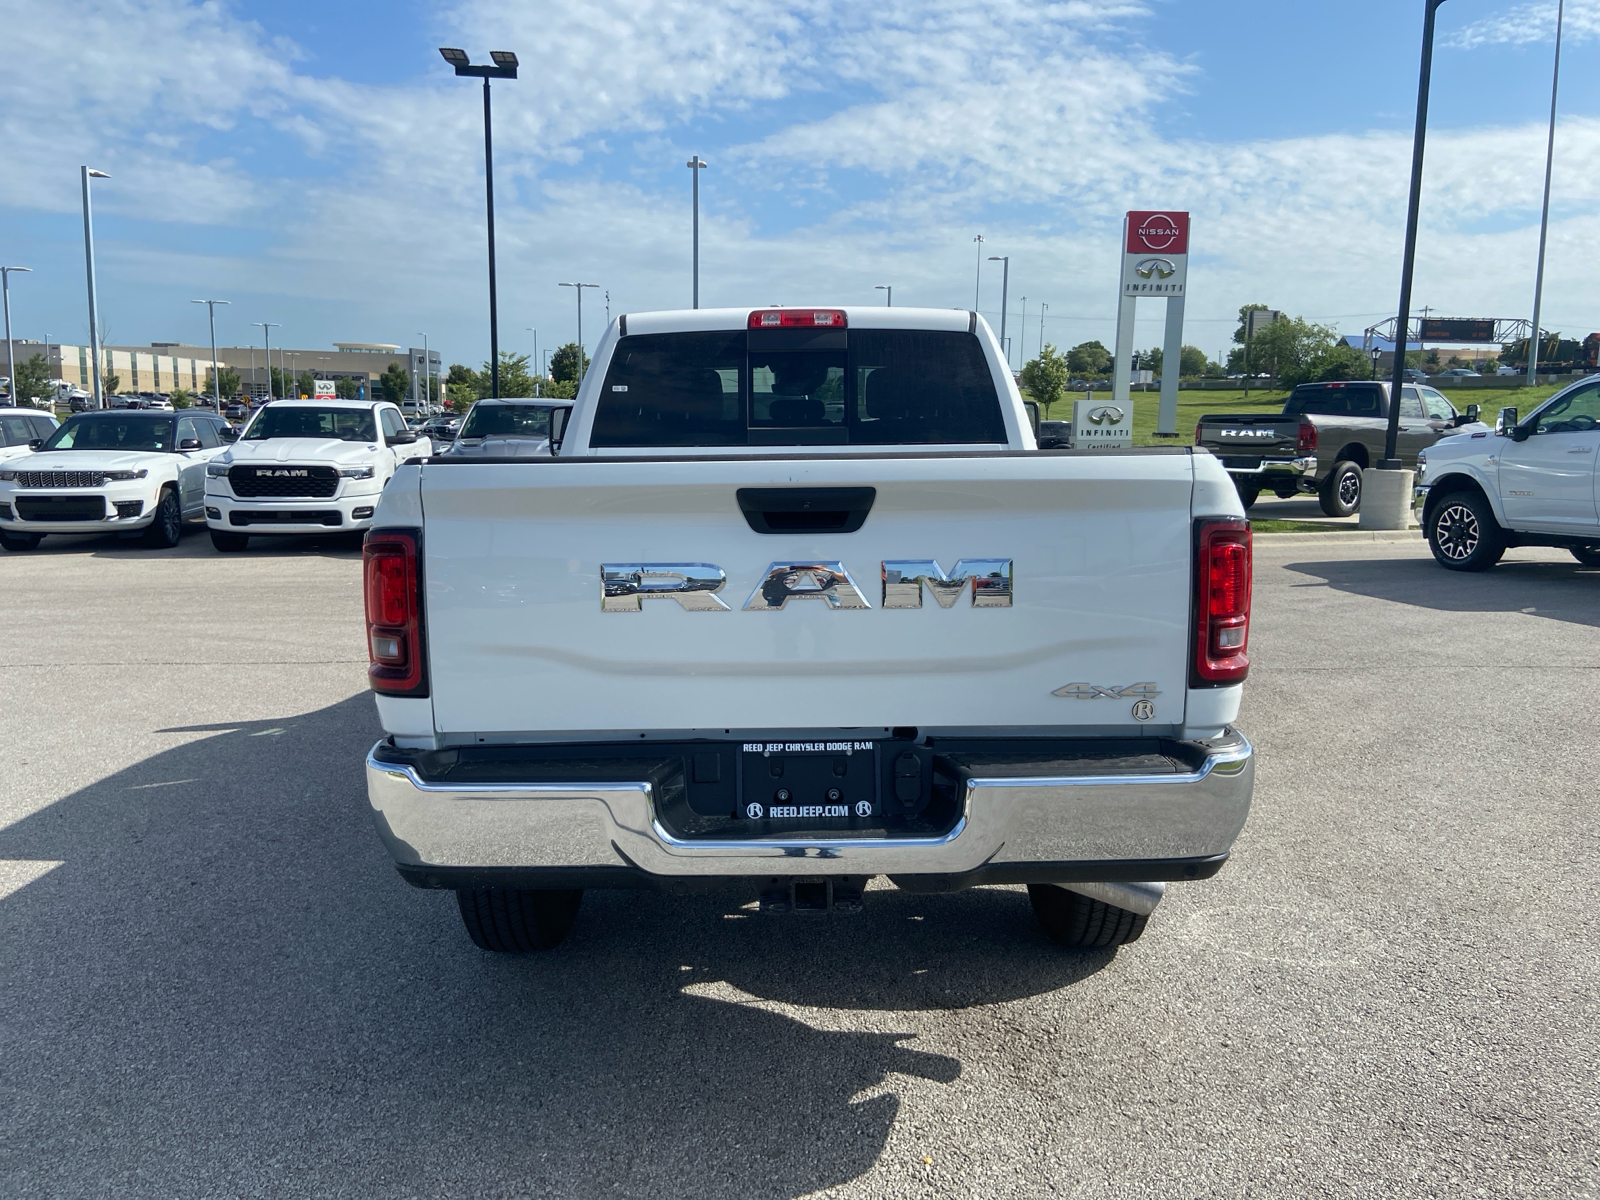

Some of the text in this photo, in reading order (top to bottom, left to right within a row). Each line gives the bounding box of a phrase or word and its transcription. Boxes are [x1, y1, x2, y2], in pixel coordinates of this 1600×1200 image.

[1221, 429, 1275, 438] RAM
[600, 558, 1014, 612] RAM
[743, 742, 873, 752] REED JEEP CHRYSLER DODGE RAM
[769, 805, 849, 818] REEDJEEP.COM
